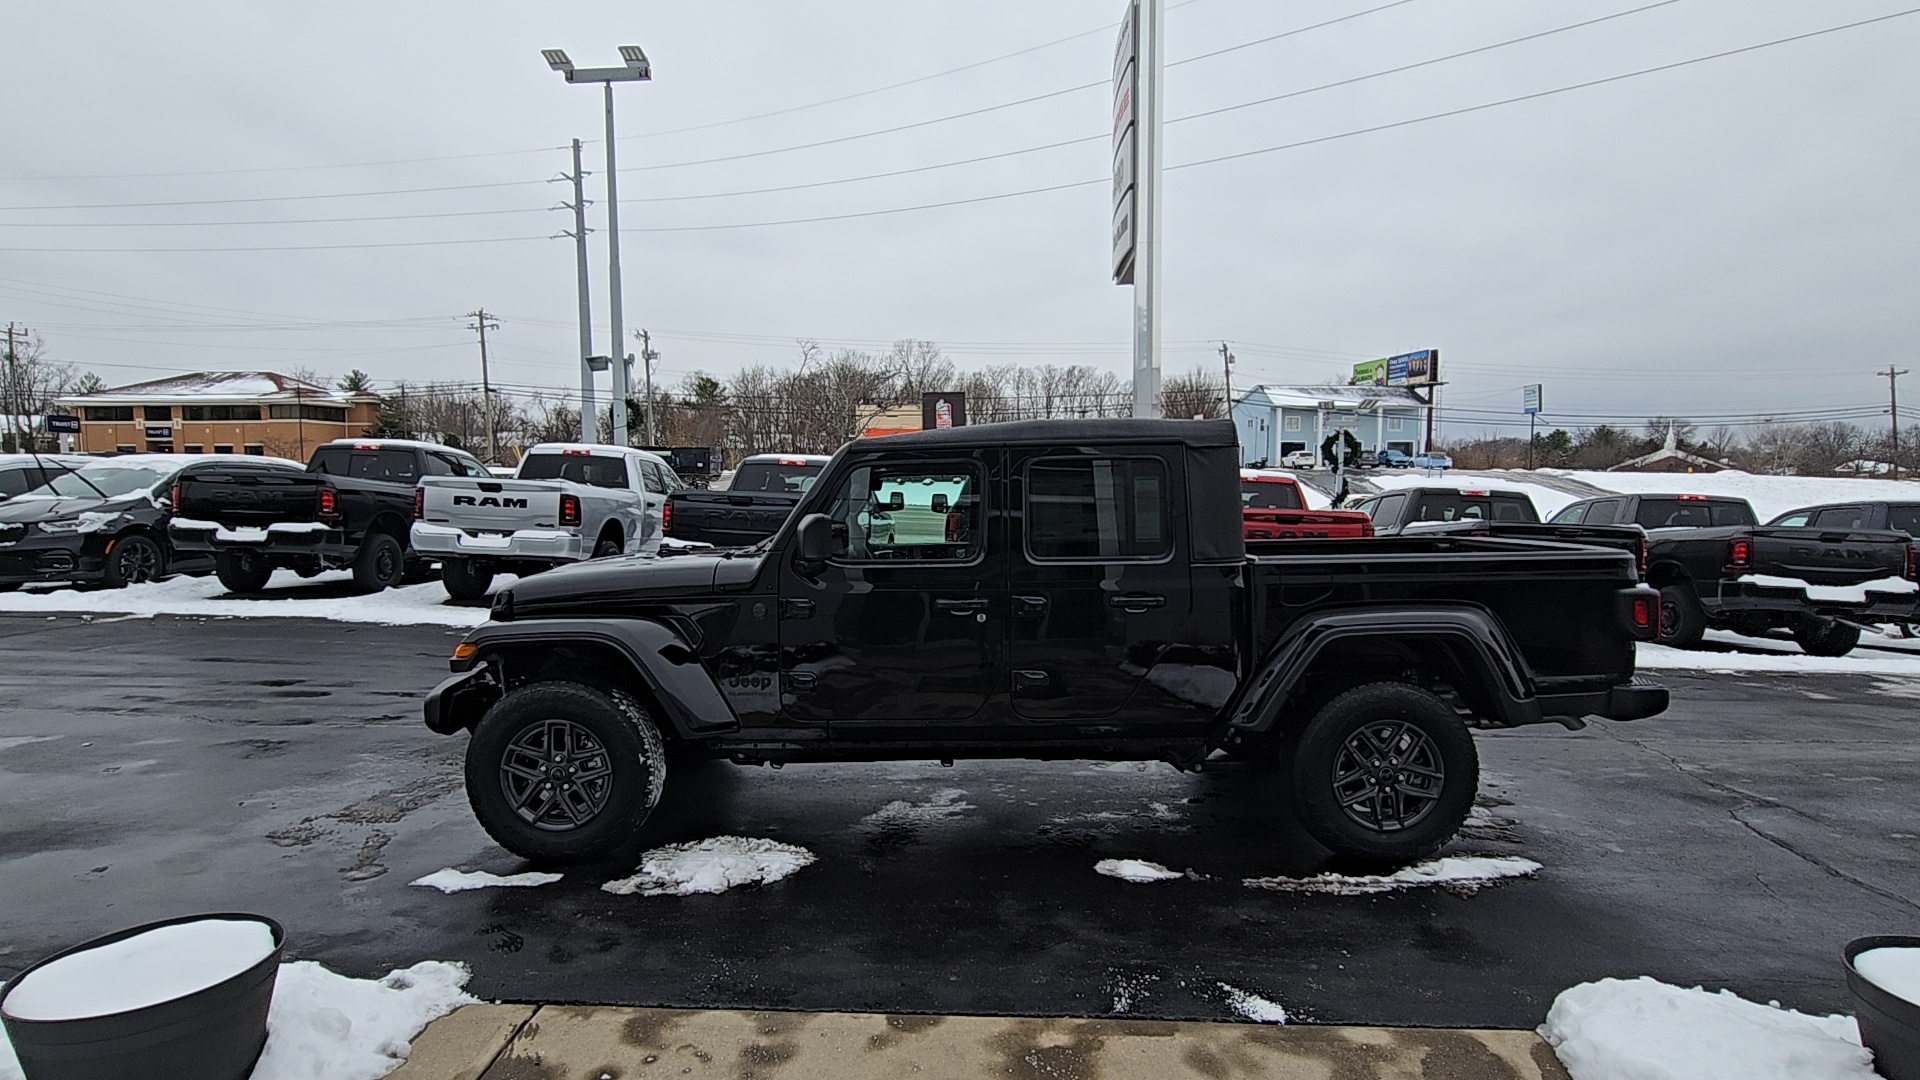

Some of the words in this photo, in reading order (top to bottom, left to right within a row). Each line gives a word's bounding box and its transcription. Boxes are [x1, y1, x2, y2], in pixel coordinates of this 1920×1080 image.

[211, 489, 284, 501] RAM
[453, 495, 528, 508] RAM
[703, 508, 778, 521] RAM
[1247, 529, 1328, 539] RAM
[1789, 545, 1881, 561] RAM
[728, 673, 772, 691] Jeep
